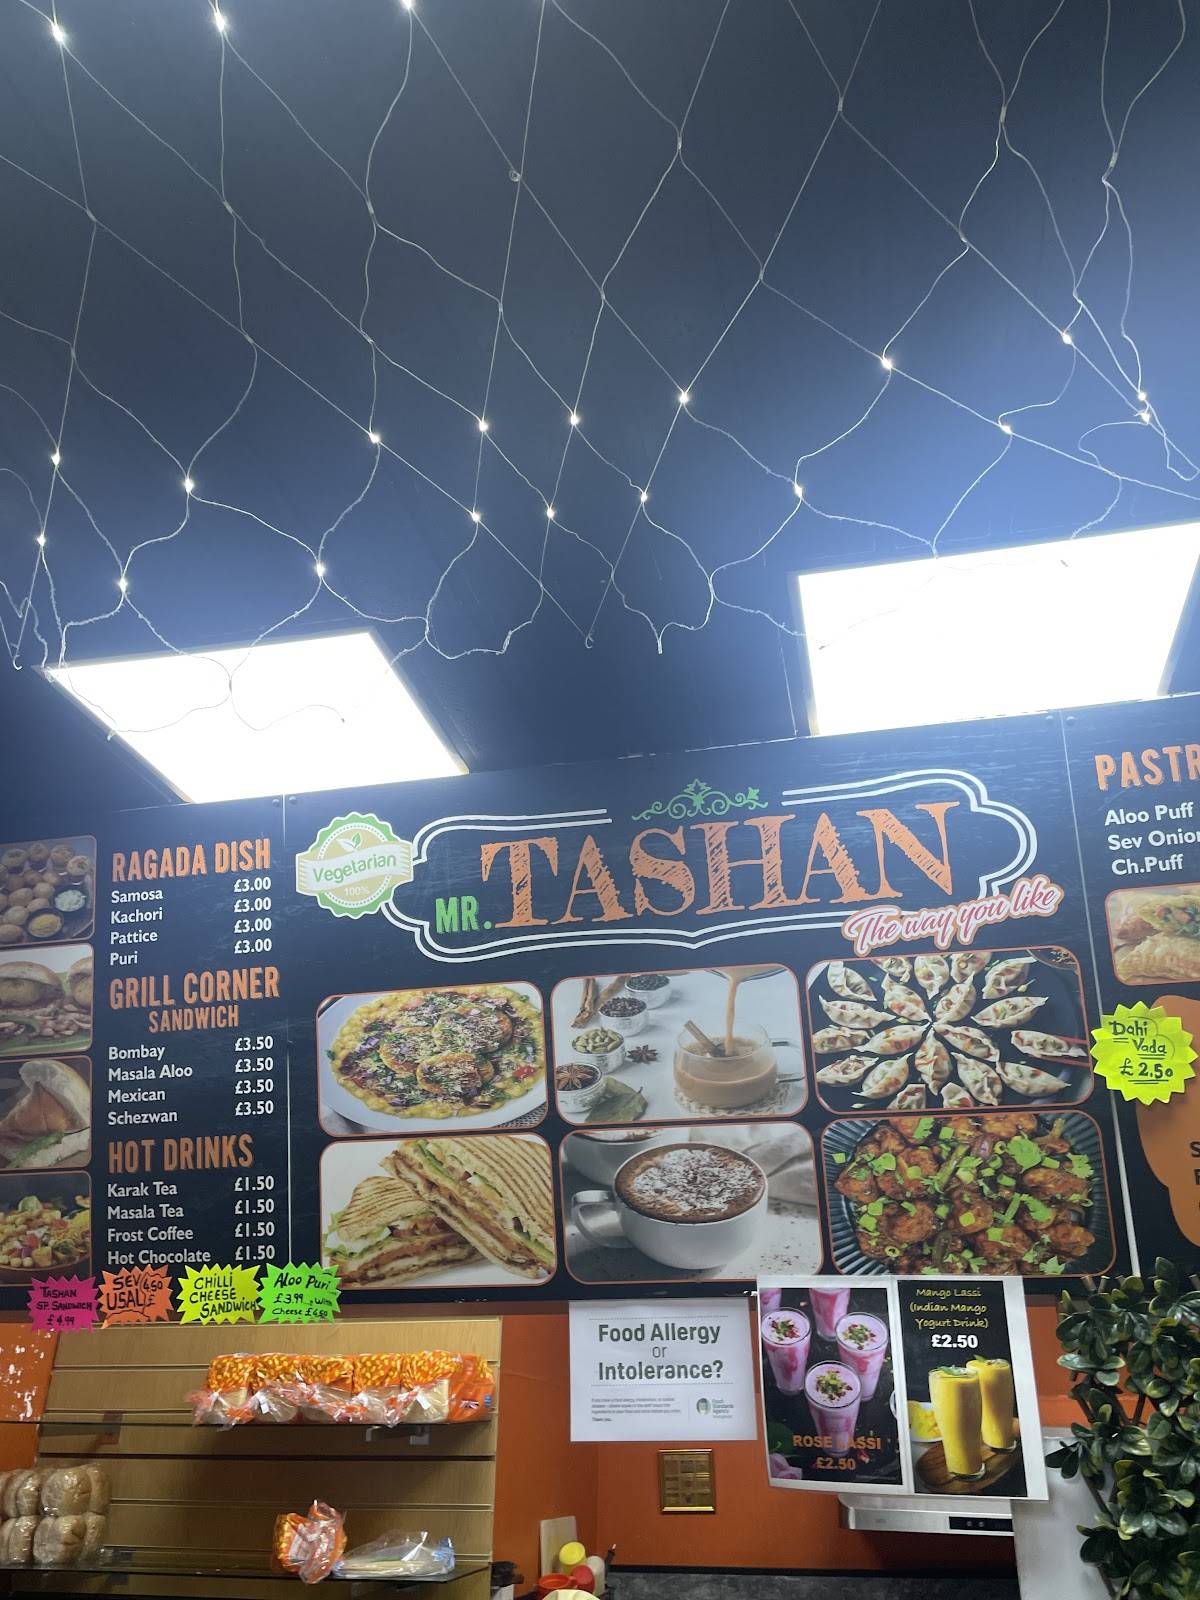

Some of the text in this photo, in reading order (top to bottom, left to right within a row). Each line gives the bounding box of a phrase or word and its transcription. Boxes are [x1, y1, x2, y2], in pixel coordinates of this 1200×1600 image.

[1104, 801, 1194, 826] Aloo Puff
[1107, 834, 1143, 851] Sev
[112, 838, 271, 883] RAGADA DISH
[312, 854, 397, 884] Vegetarian
[480, 801, 960, 927] TASHAN
[1111, 854, 1184, 876] Ch.Puff
[111, 876, 272, 904] Samosa £3.00
[110, 897, 272, 925] Kachori £3.00
[435, 895, 492, 934] MR.
[848, 879, 1056, 951] The way you like
[110, 917, 272, 945] Pattice £3.00
[109, 938, 273, 966] Puri £3.00
[109, 966, 281, 1010] GRILL CORNER
[148, 1004, 239, 1034] SANDWICH
[108, 1035, 274, 1061] Bombay £3.50
[1131, 1038, 1167, 1054] Vada
[108, 1057, 274, 1082] Masala Aloo £3.50
[108, 1078, 274, 1104] Mexican £3.50
[107, 1100, 275, 1126] Schezwan £3.50
[108, 1133, 254, 1174] HOT DRINKS
[107, 1175, 275, 1198] Karak Tea £1.50
[107, 1198, 275, 1220] Masala Tea £1.50
[107, 1221, 275, 1243] Frost Coffee £1.50
[107, 1244, 276, 1265] Hot Chocolate £1.50
[40, 1286, 77, 1298] TASHAN
[112, 1274, 141, 1290] SEV
[273, 1272, 331, 1290] Aloo Puri
[189, 1287, 237, 1304] CHEESE
[916, 1287, 982, 1300] Mango Lassi
[909, 1301, 987, 1315] (Indian Mango
[598, 1323, 721, 1344] Food Allergy
[915, 1317, 989, 1330] Yogurt Drink)
[931, 1333, 979, 1349] £2.50
[598, 1359, 723, 1381] Intolerance?
[792, 1434, 833, 1448] ROSE
[816, 1456, 856, 1470] £2.50
